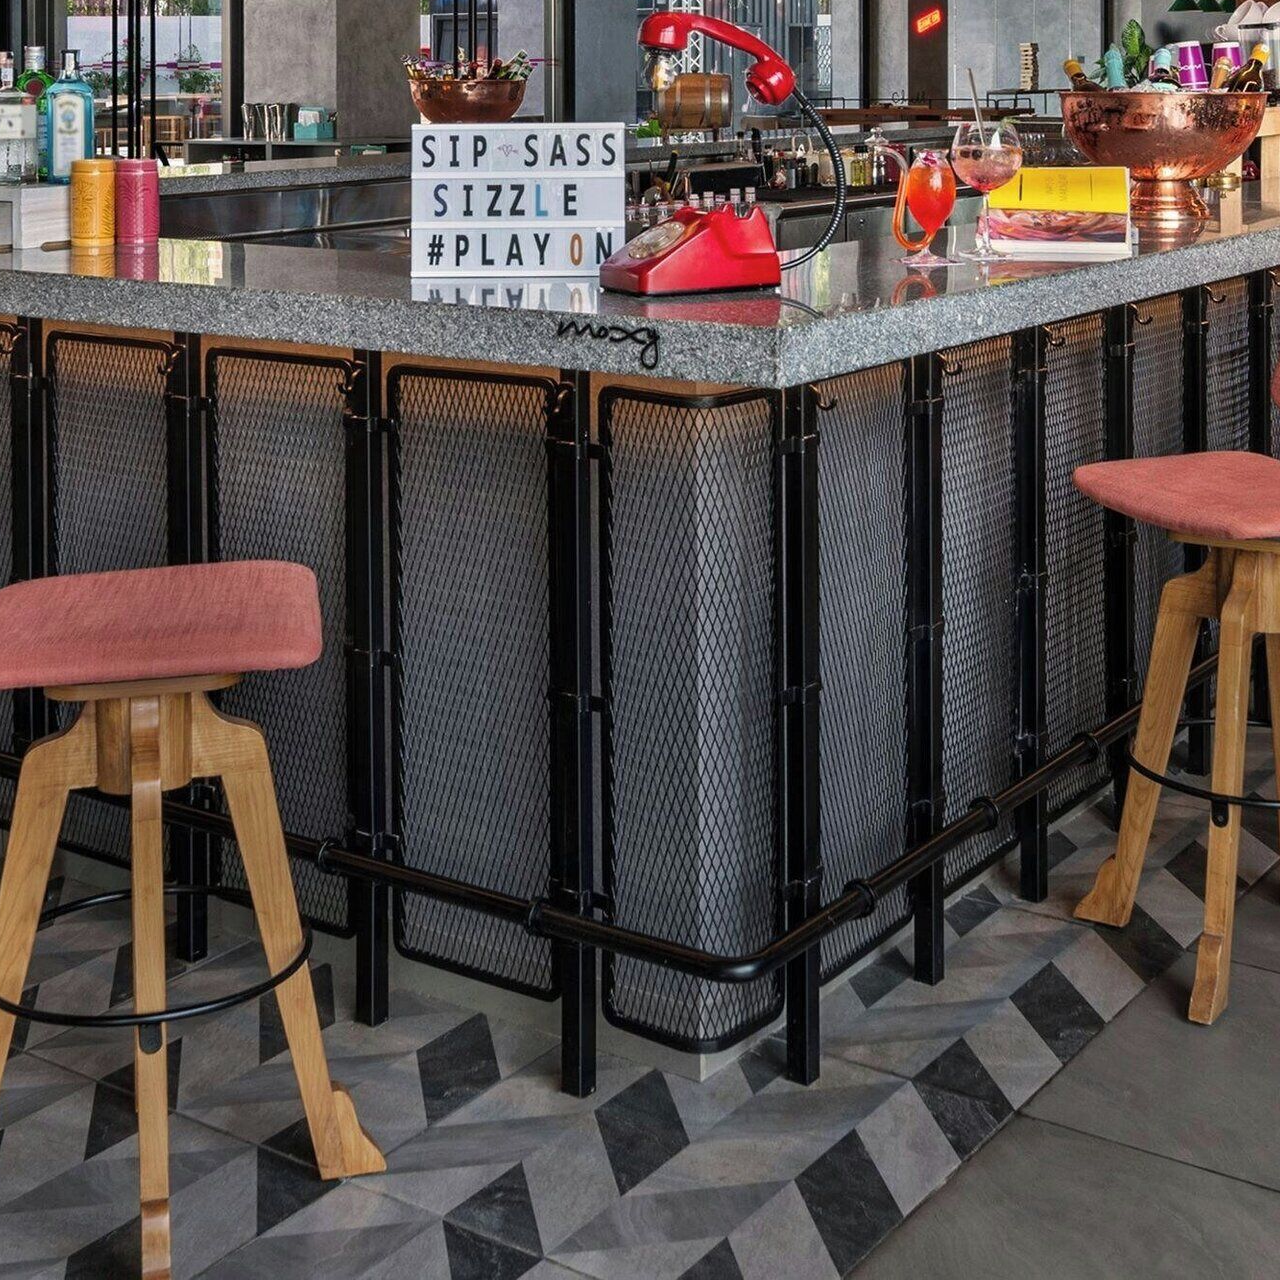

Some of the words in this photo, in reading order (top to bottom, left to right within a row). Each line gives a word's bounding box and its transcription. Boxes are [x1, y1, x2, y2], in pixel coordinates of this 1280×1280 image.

[421, 134, 488, 168] SIP
[523, 133, 617, 167] SASS
[433, 183, 578, 218] SIZZLE
[427, 232, 552, 267] #PLAY
[569, 233, 612, 267] ON
[557, 320, 661, 370] moxy
